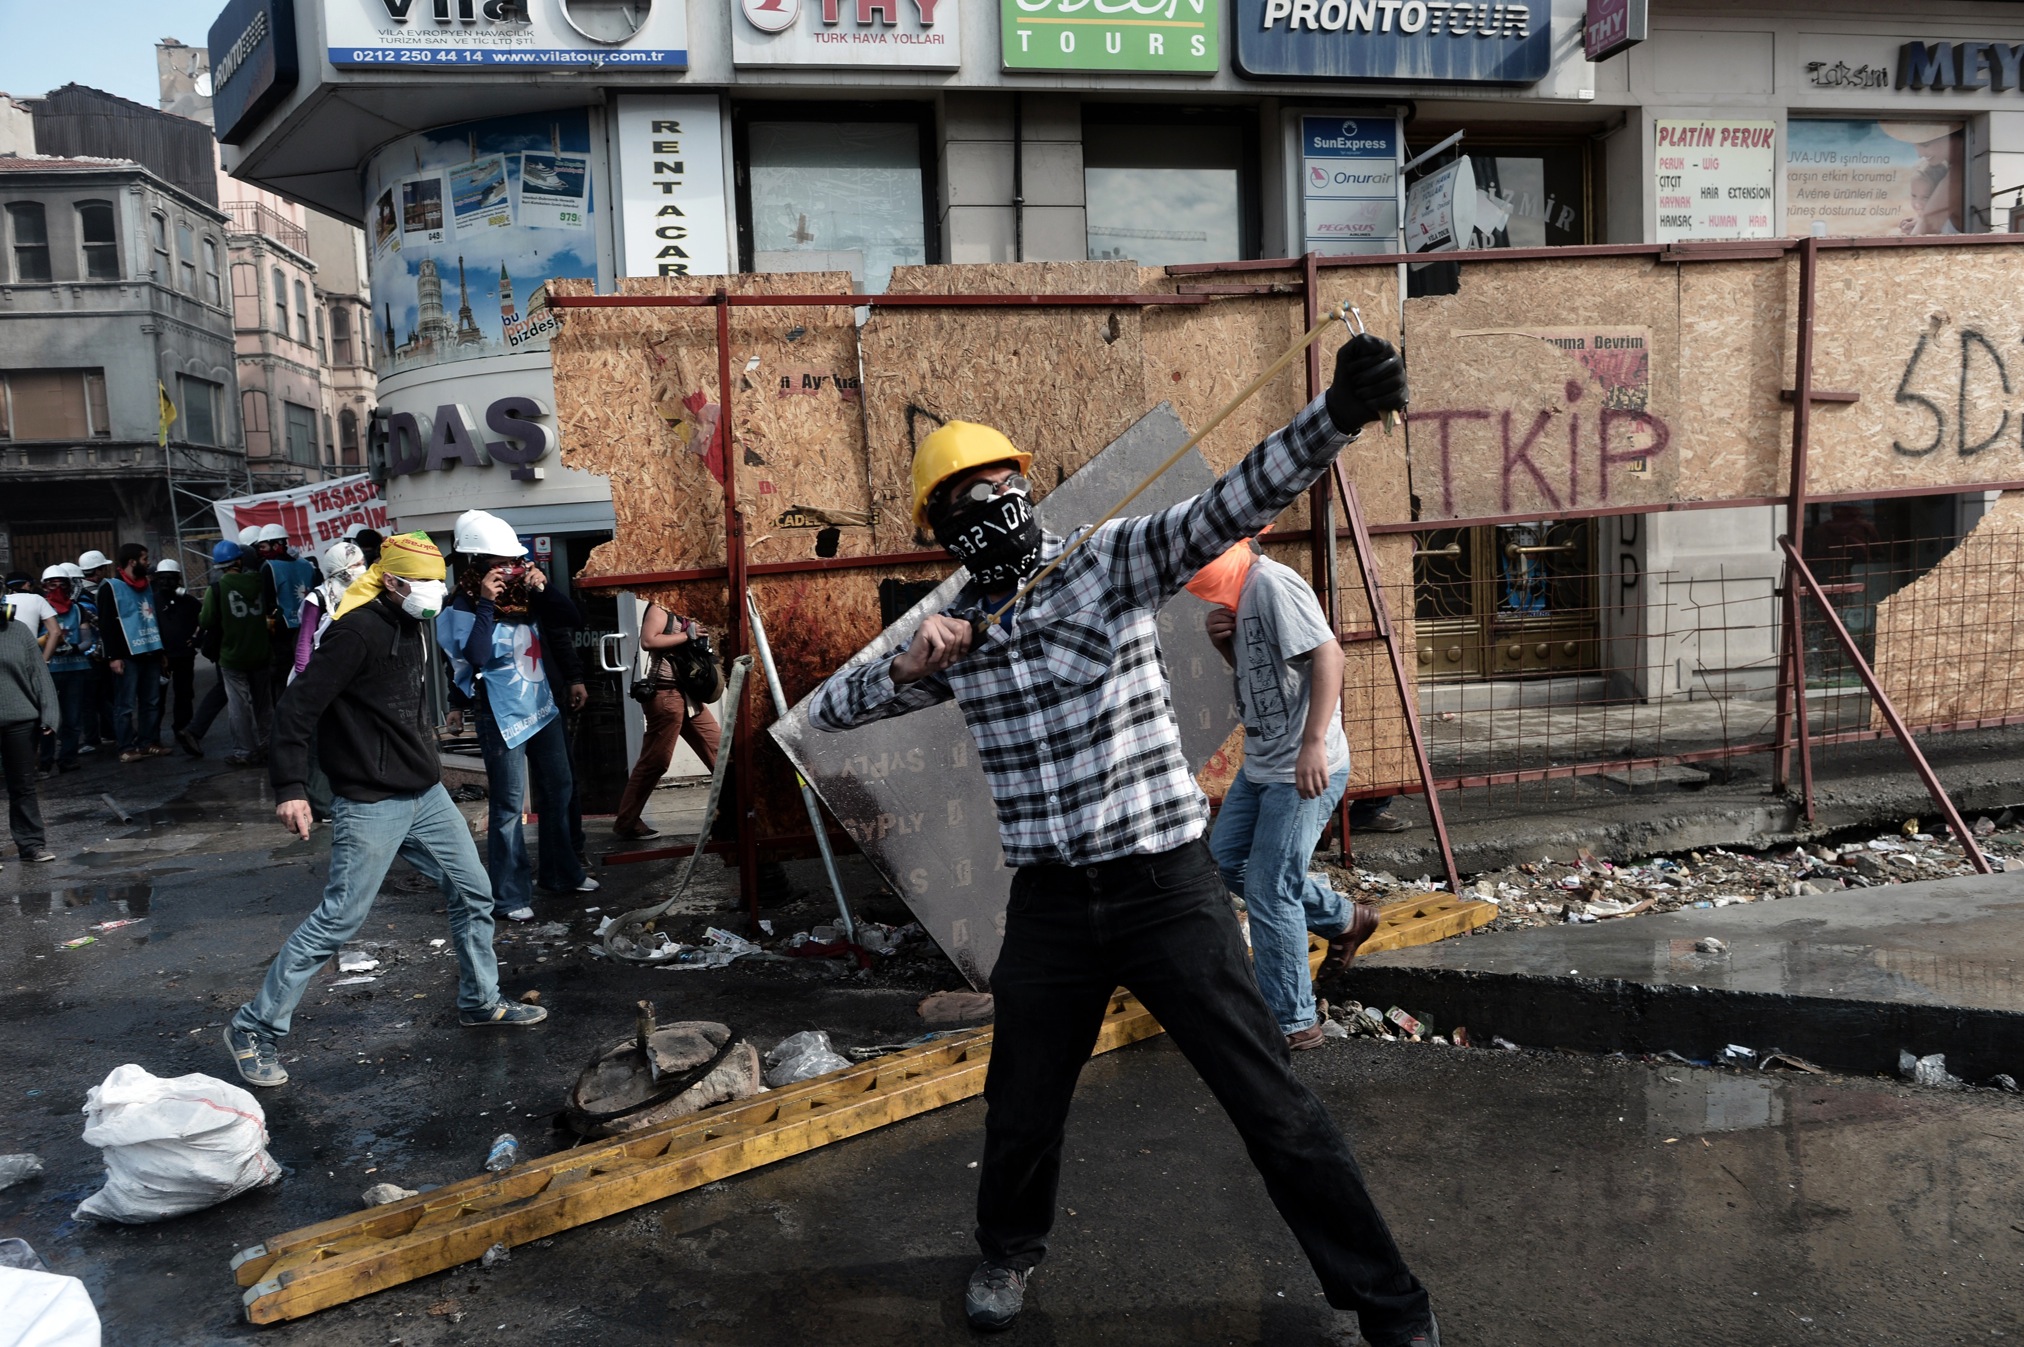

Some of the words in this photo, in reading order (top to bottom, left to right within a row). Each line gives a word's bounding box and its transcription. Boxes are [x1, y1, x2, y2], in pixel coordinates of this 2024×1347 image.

[1263, 0, 1530, 37] PRONTOTOUR
[1588, 8, 1625, 45] THY
[853, 33, 888, 44] HAVA
[892, 33, 945, 45] YOLLARI
[1016, 30, 1206, 56] TOURS
[352, 49, 397, 63] 0212
[399, 49, 434, 63] 250
[436, 49, 460, 63] 44
[462, 49, 483, 63] 14
[492, 48, 665, 64] www.vilatour.com.tr
[1657, 122, 1716, 148] PLATİN
[1719, 127, 1775, 149] PERUK
[1313, 136, 1387, 151] SunExpress
[1659, 157, 1685, 170] PERUK
[1840, 152, 1891, 167] ışınlarına
[1334, 171, 1393, 185] Onurair
[1821, 170, 1848, 182] etkin
[1851, 170, 1897, 182] koruma!
[1833, 188, 1874, 200] ürünleri
[1875, 188, 1888, 200] ile
[1487, 181, 1576, 232] İZMİR
[1659, 196, 1692, 209] KAYNAK
[1818, 205, 1867, 216] dostunuz
[1869, 205, 1902, 216] olsun!
[1316, 223, 1377, 232] PEGASUS
[1659, 214, 1693, 231] HAMSAÇ
[1708, 214, 1738, 227] HUMAN
[501, 312, 520, 326] bu
[1594, 335, 1643, 349] Devrim
[1404, 378, 1671, 514] TKİP
